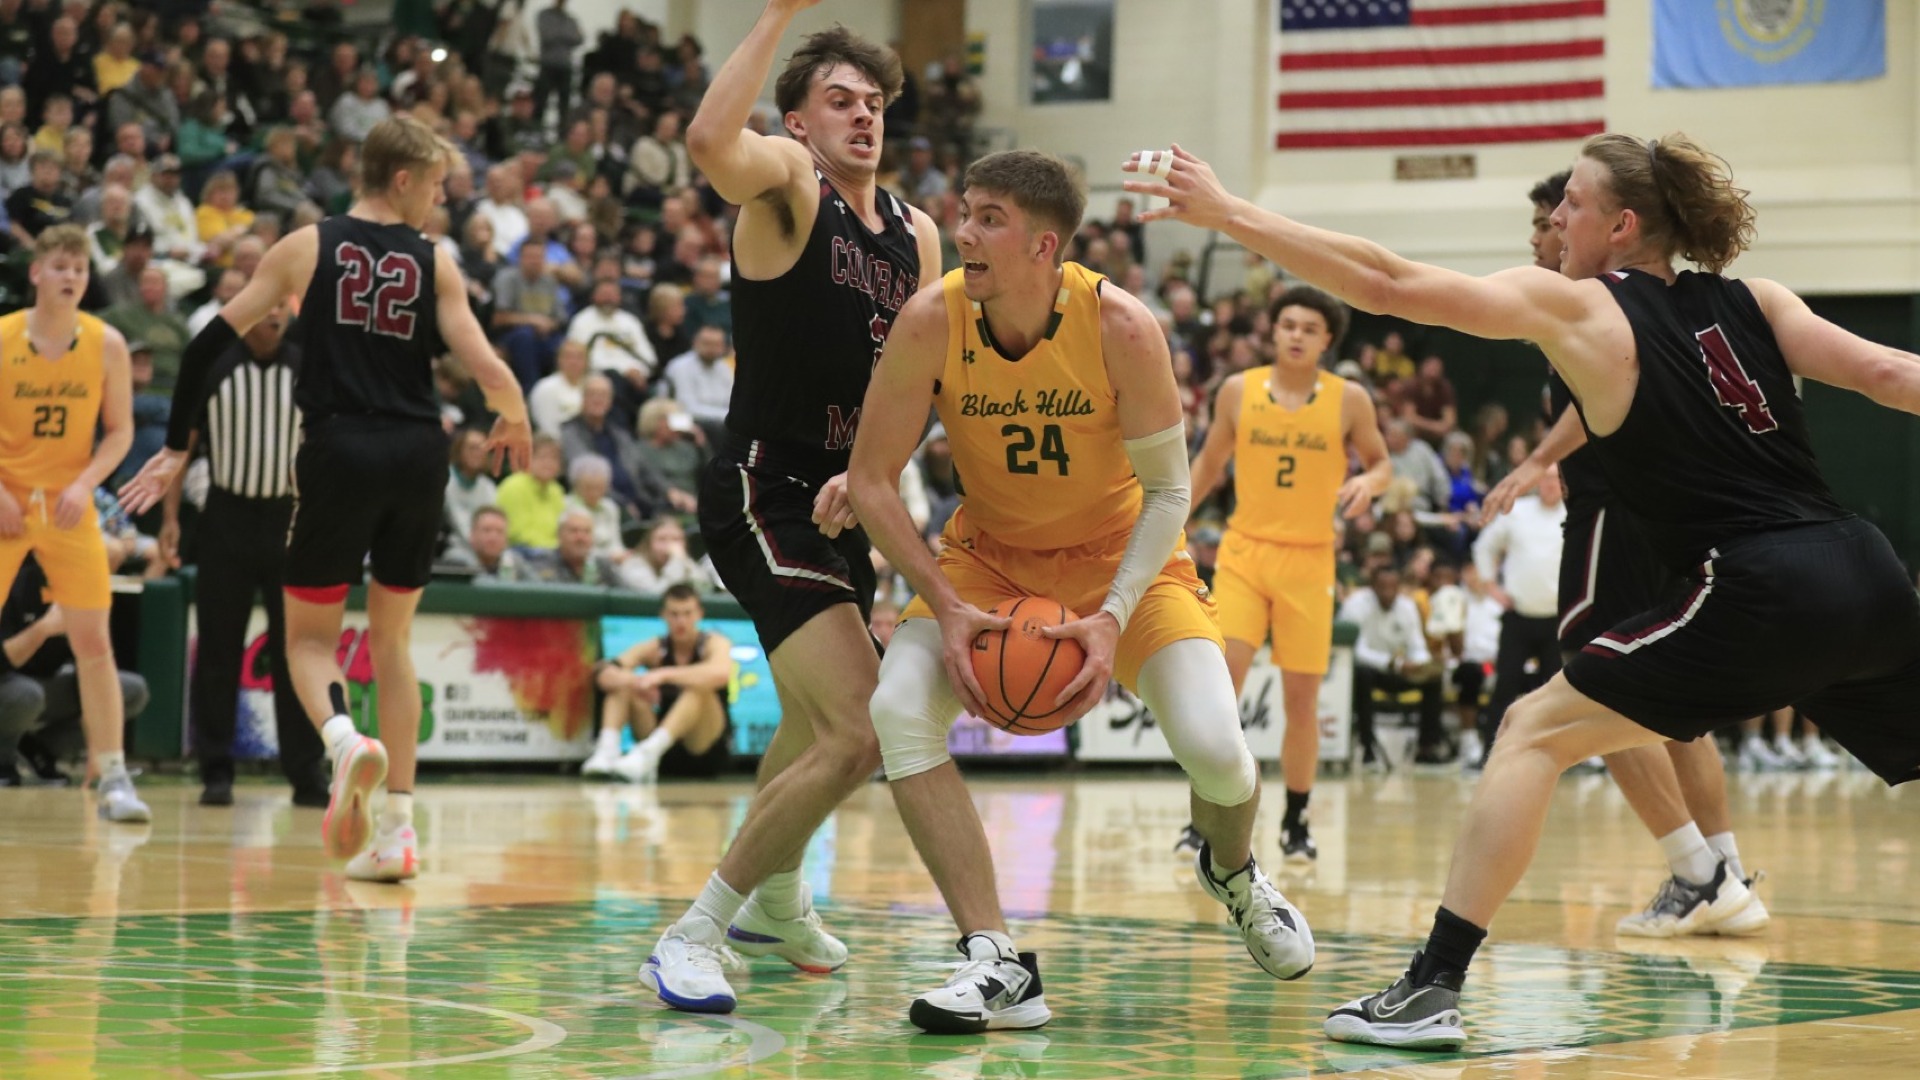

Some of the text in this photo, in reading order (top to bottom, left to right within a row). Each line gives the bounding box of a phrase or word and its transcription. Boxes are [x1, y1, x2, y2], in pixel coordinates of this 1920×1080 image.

[335, 241, 421, 340] 22
[1695, 323, 1778, 434] 4
[33, 405, 67, 438] 23
[961, 389, 1095, 418] Black Hills
[1001, 424, 1070, 476] 24
[1277, 455, 1295, 488] 2
